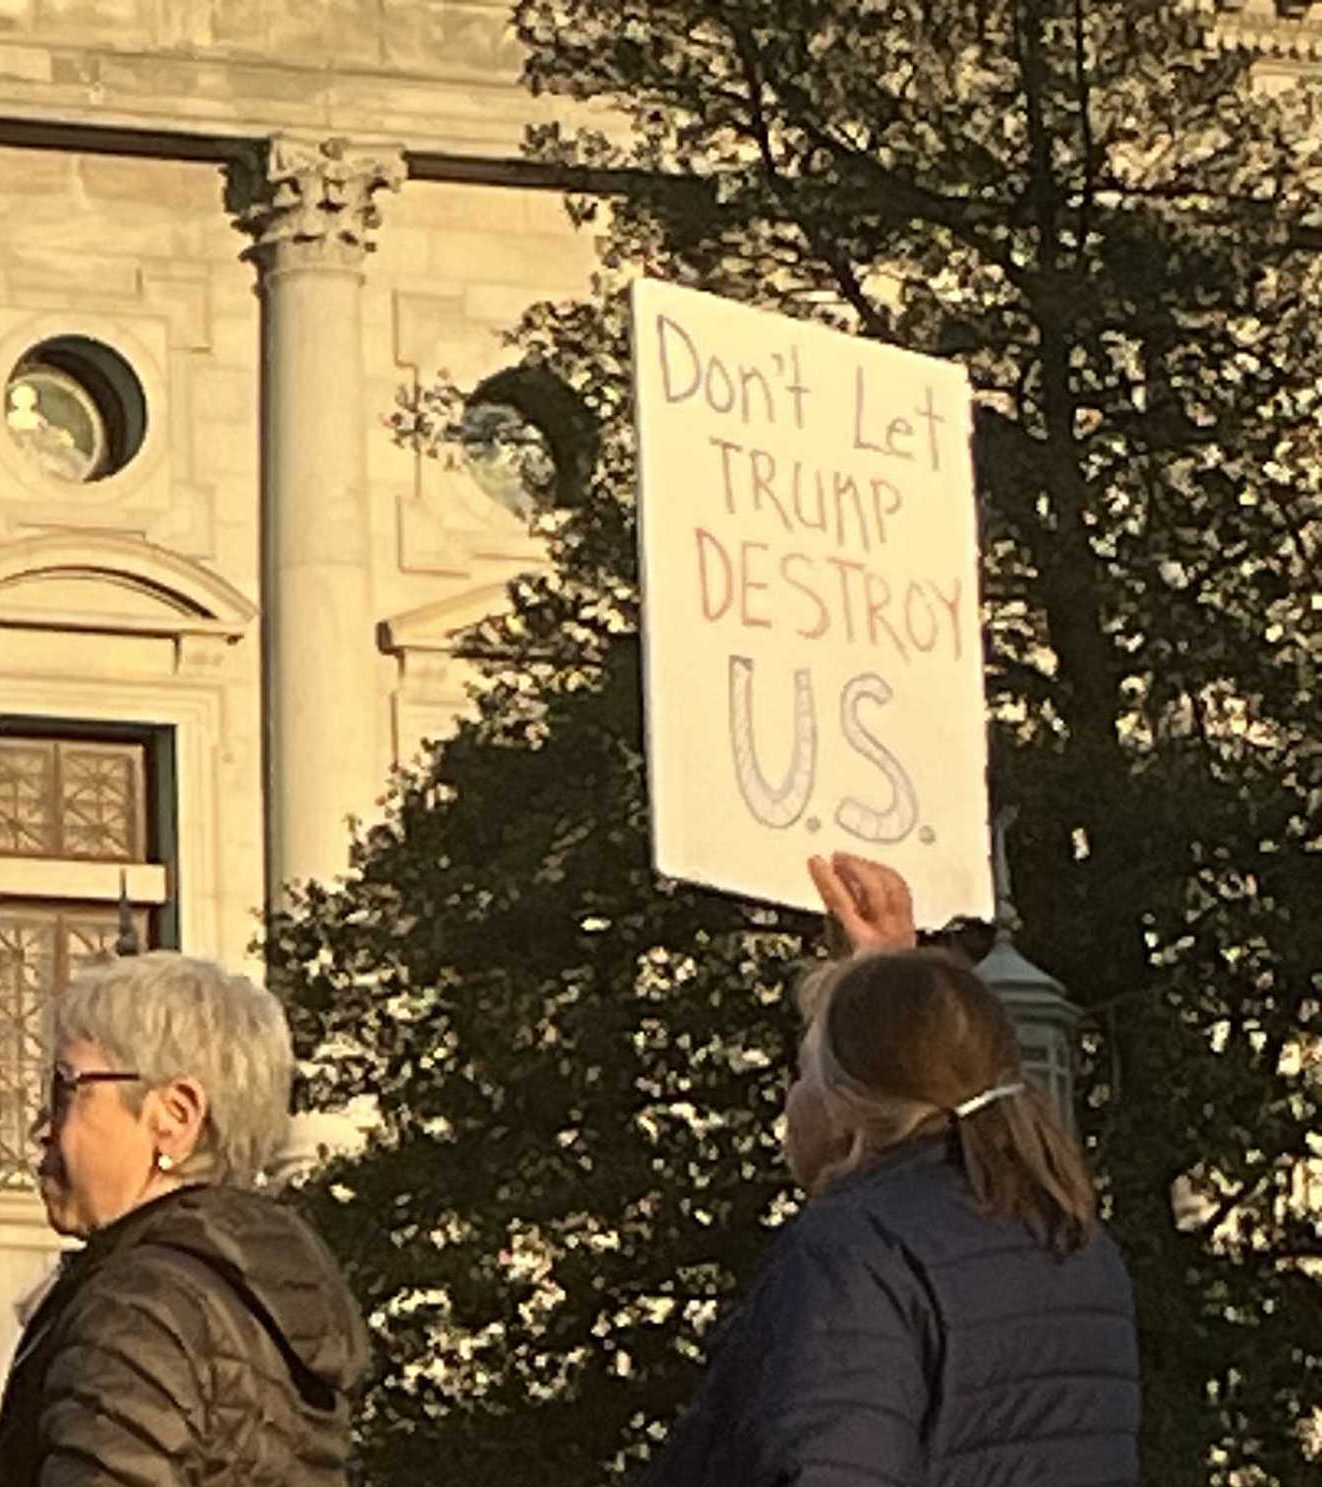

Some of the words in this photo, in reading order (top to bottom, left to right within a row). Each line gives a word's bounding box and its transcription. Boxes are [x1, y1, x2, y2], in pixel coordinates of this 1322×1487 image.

[656, 313, 812, 430] Don't
[852, 365, 946, 472] Let
[709, 436, 904, 555] TRUMP
[694, 526, 964, 662] DESTROY
[728, 653, 937, 846] U.S.
